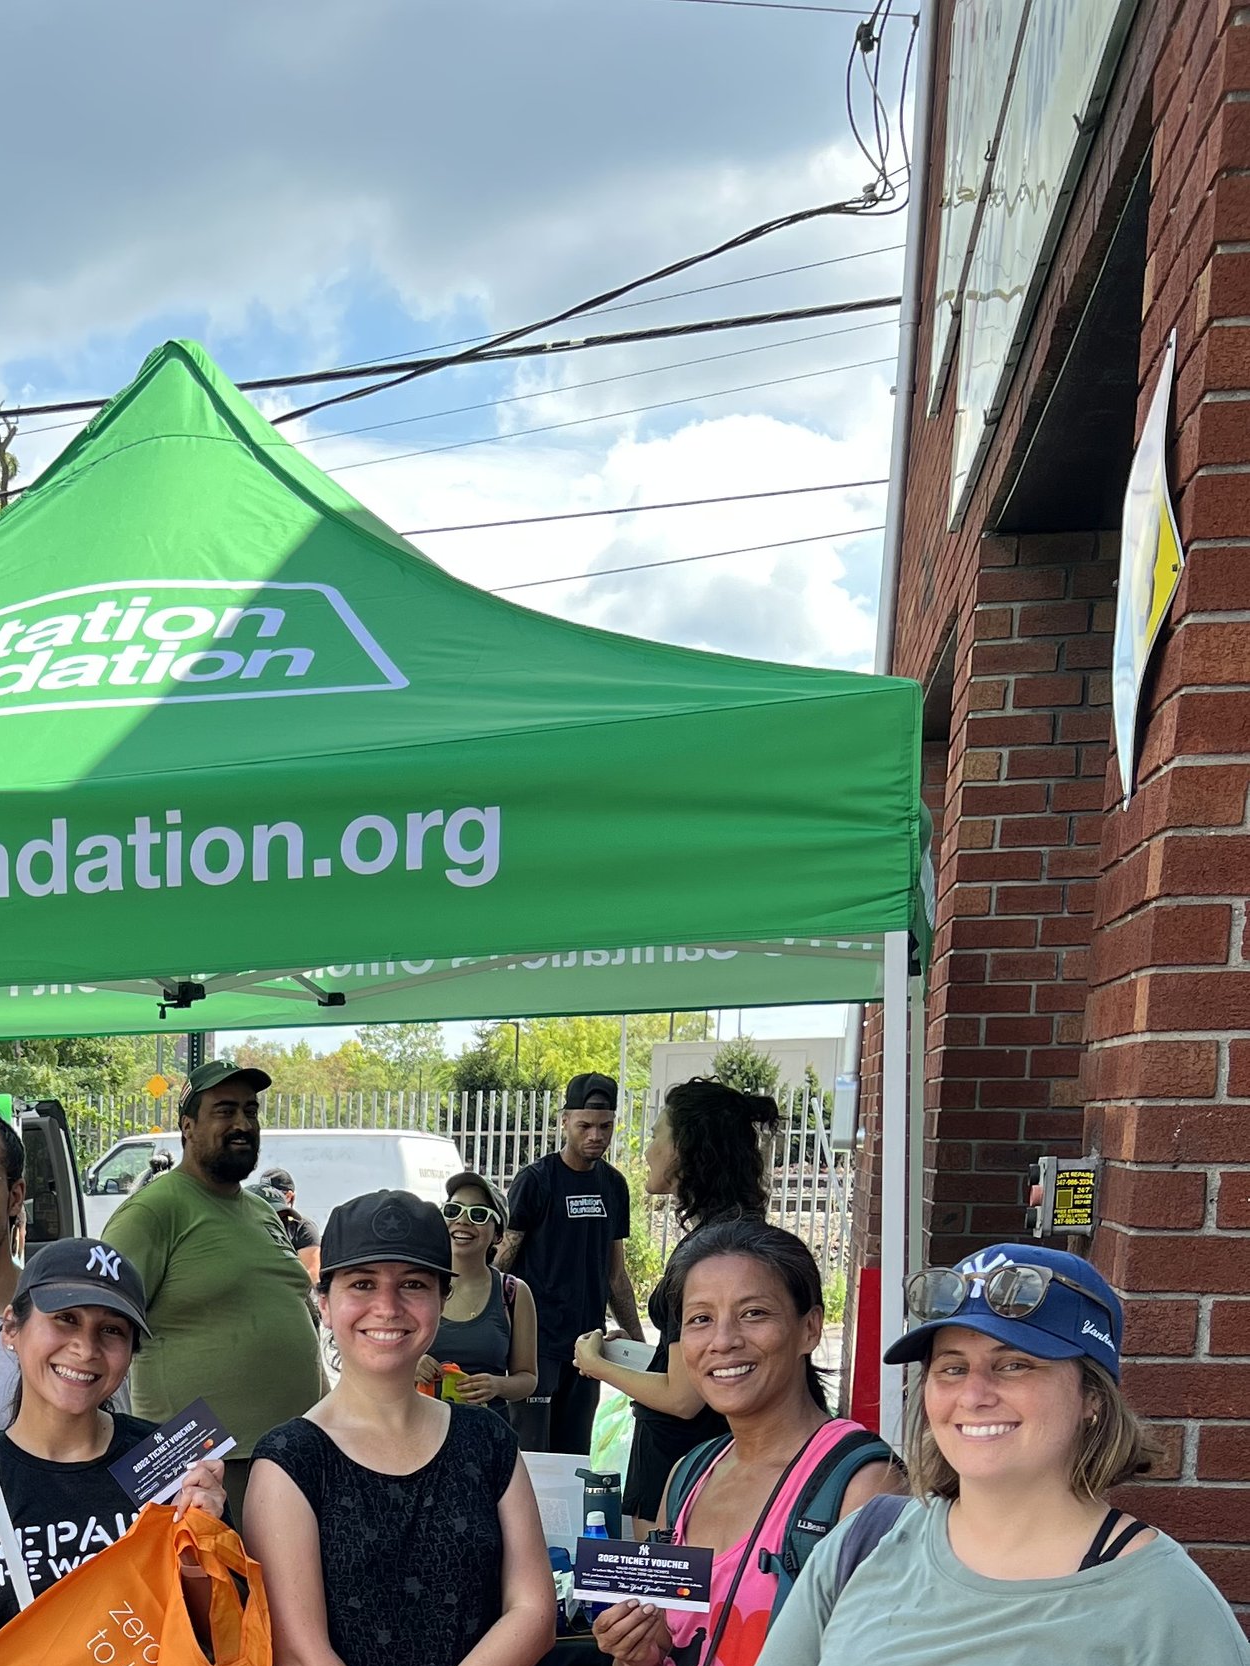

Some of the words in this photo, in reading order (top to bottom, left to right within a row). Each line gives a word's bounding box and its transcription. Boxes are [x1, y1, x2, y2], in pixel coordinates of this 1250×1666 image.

[86, 1246, 121, 1280] NY
[132, 1456, 150, 1473] 2022
[147, 1440, 171, 1461] TICKET
[168, 1419, 197, 1444] VOUCHER
[597, 1553, 619, 1563] 2022
[620, 1555, 649, 1566] TICKET
[651, 1558, 689, 1569] VOUCHER
[87, 1628, 115, 1664] to
[109, 1600, 161, 1664] zero
